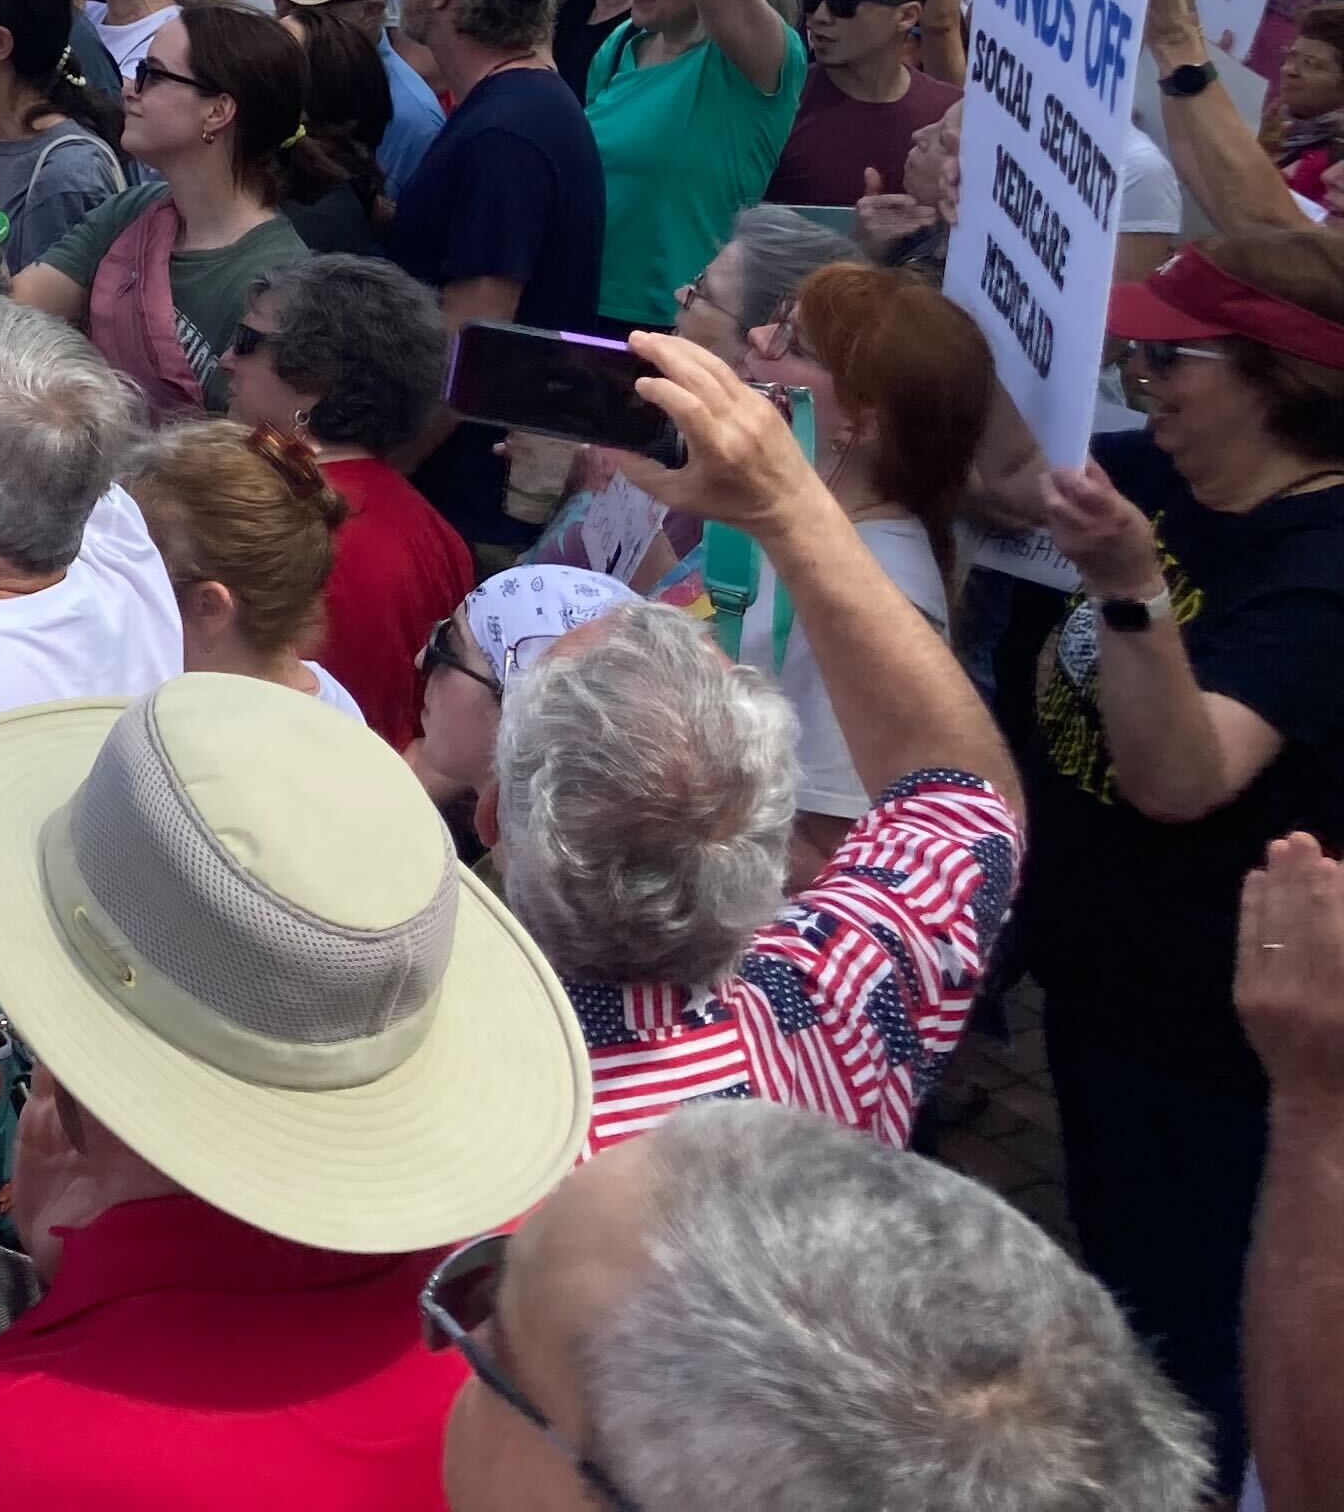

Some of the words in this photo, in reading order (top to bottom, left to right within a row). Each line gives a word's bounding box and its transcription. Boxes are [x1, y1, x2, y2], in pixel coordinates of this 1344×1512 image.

[970, 28, 1032, 133] SOCIAL
[1039, 92, 1119, 233] SECURITY
[991, 143, 1072, 291] MEDICARE
[979, 233, 1056, 379] MEDICAID
